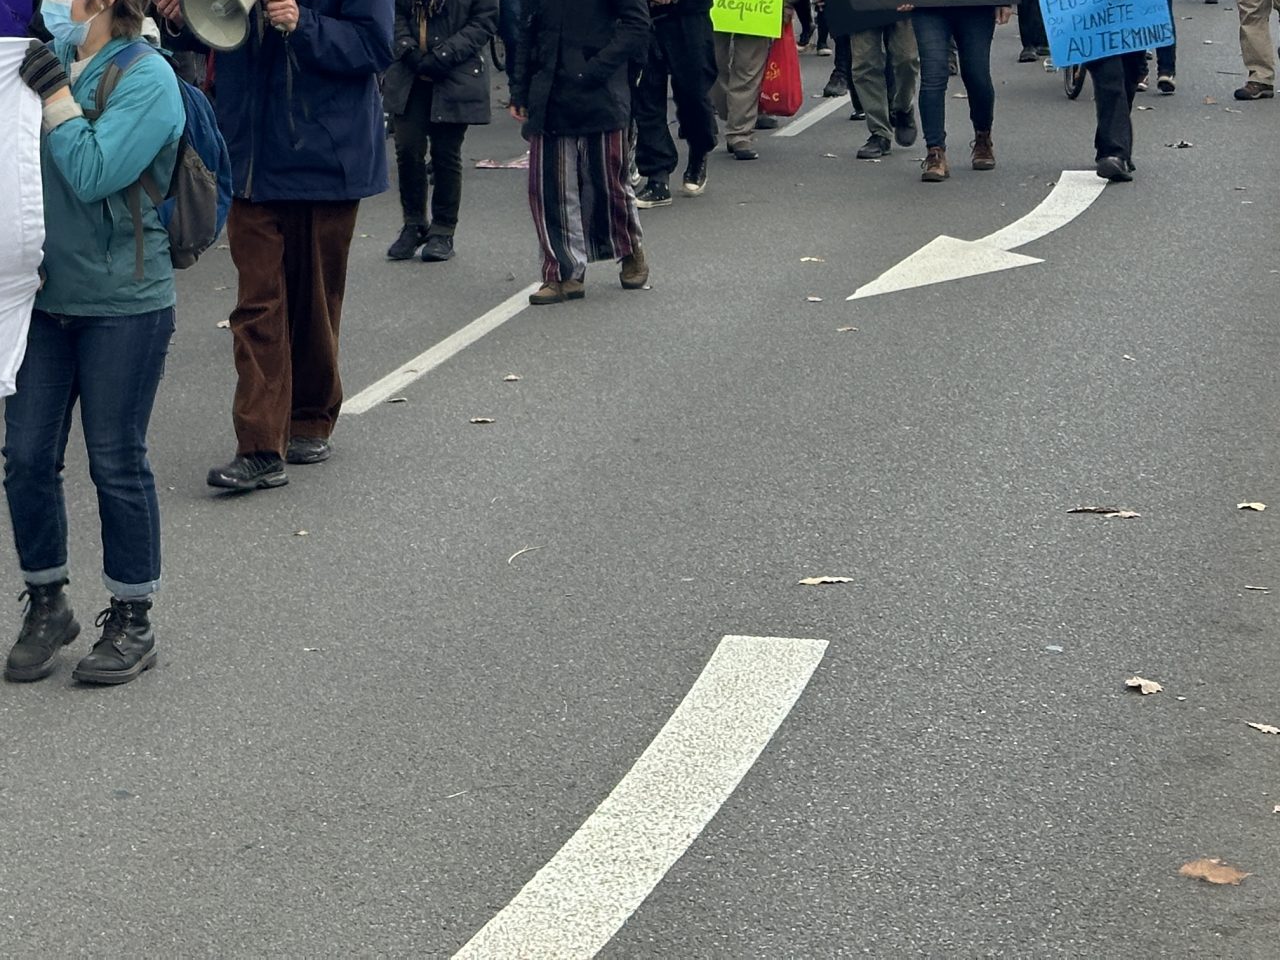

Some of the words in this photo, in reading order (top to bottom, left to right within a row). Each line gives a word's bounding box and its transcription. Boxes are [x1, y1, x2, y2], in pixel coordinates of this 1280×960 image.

[1072, 2, 1134, 32] PLANÈTE
[1067, 35, 1093, 61] AU
[1096, 22, 1174, 52] TERMINUS
